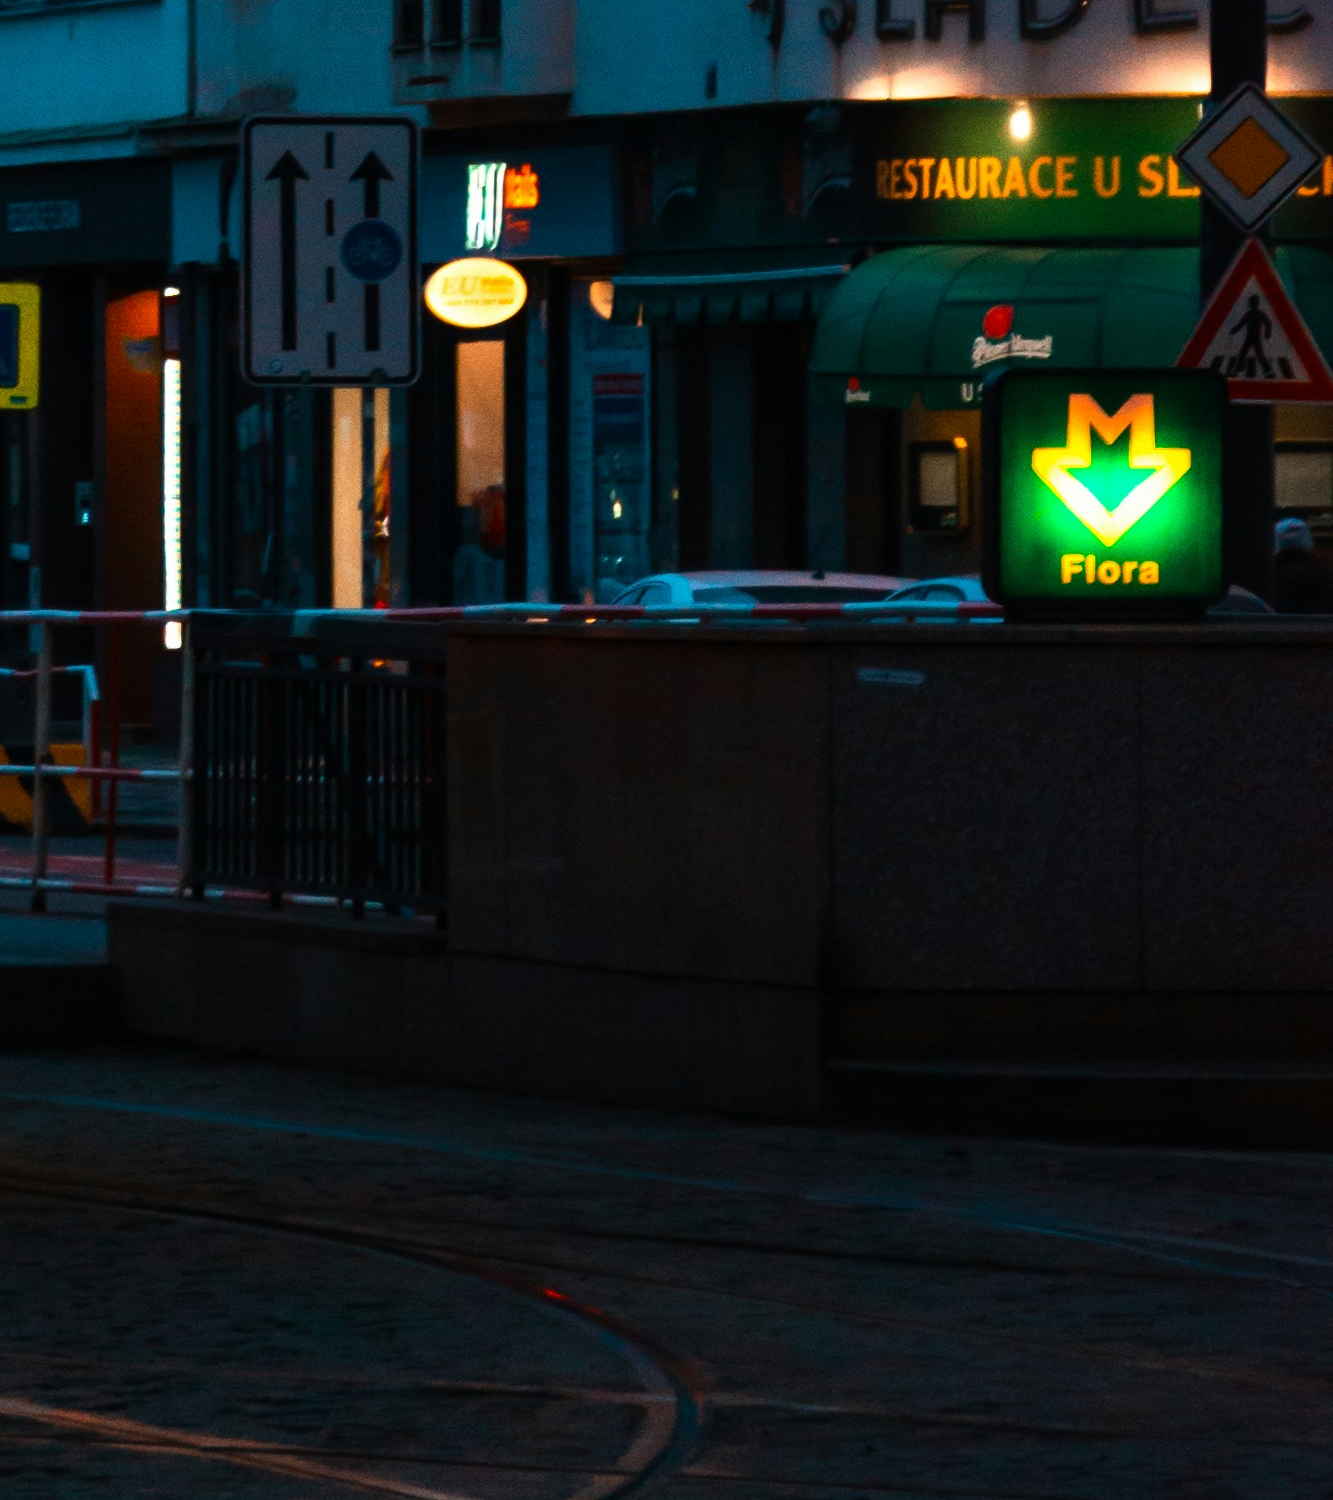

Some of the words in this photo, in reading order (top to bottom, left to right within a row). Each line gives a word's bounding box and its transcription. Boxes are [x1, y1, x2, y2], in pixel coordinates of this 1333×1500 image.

[876, 155, 1079, 200] RESTAURACE
[1093, 155, 1122, 199] U
[1060, 553, 1160, 585] Flora
